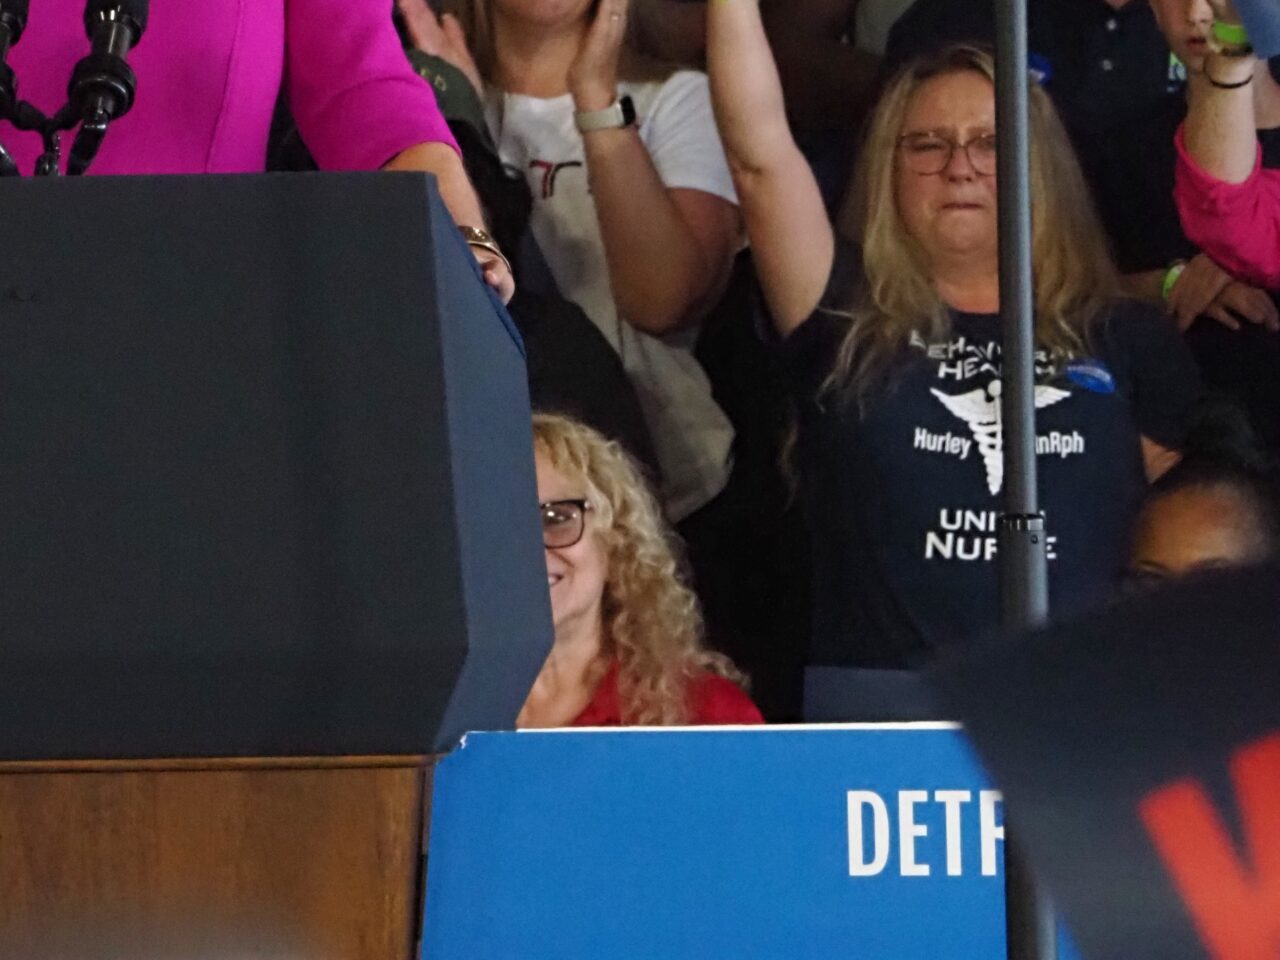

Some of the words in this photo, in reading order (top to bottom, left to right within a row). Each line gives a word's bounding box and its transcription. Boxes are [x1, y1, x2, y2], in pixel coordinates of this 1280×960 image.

[913, 427, 972, 460] Hurley
[1035, 430, 1084, 459] nRph
[925, 532, 1057, 560] NURE
